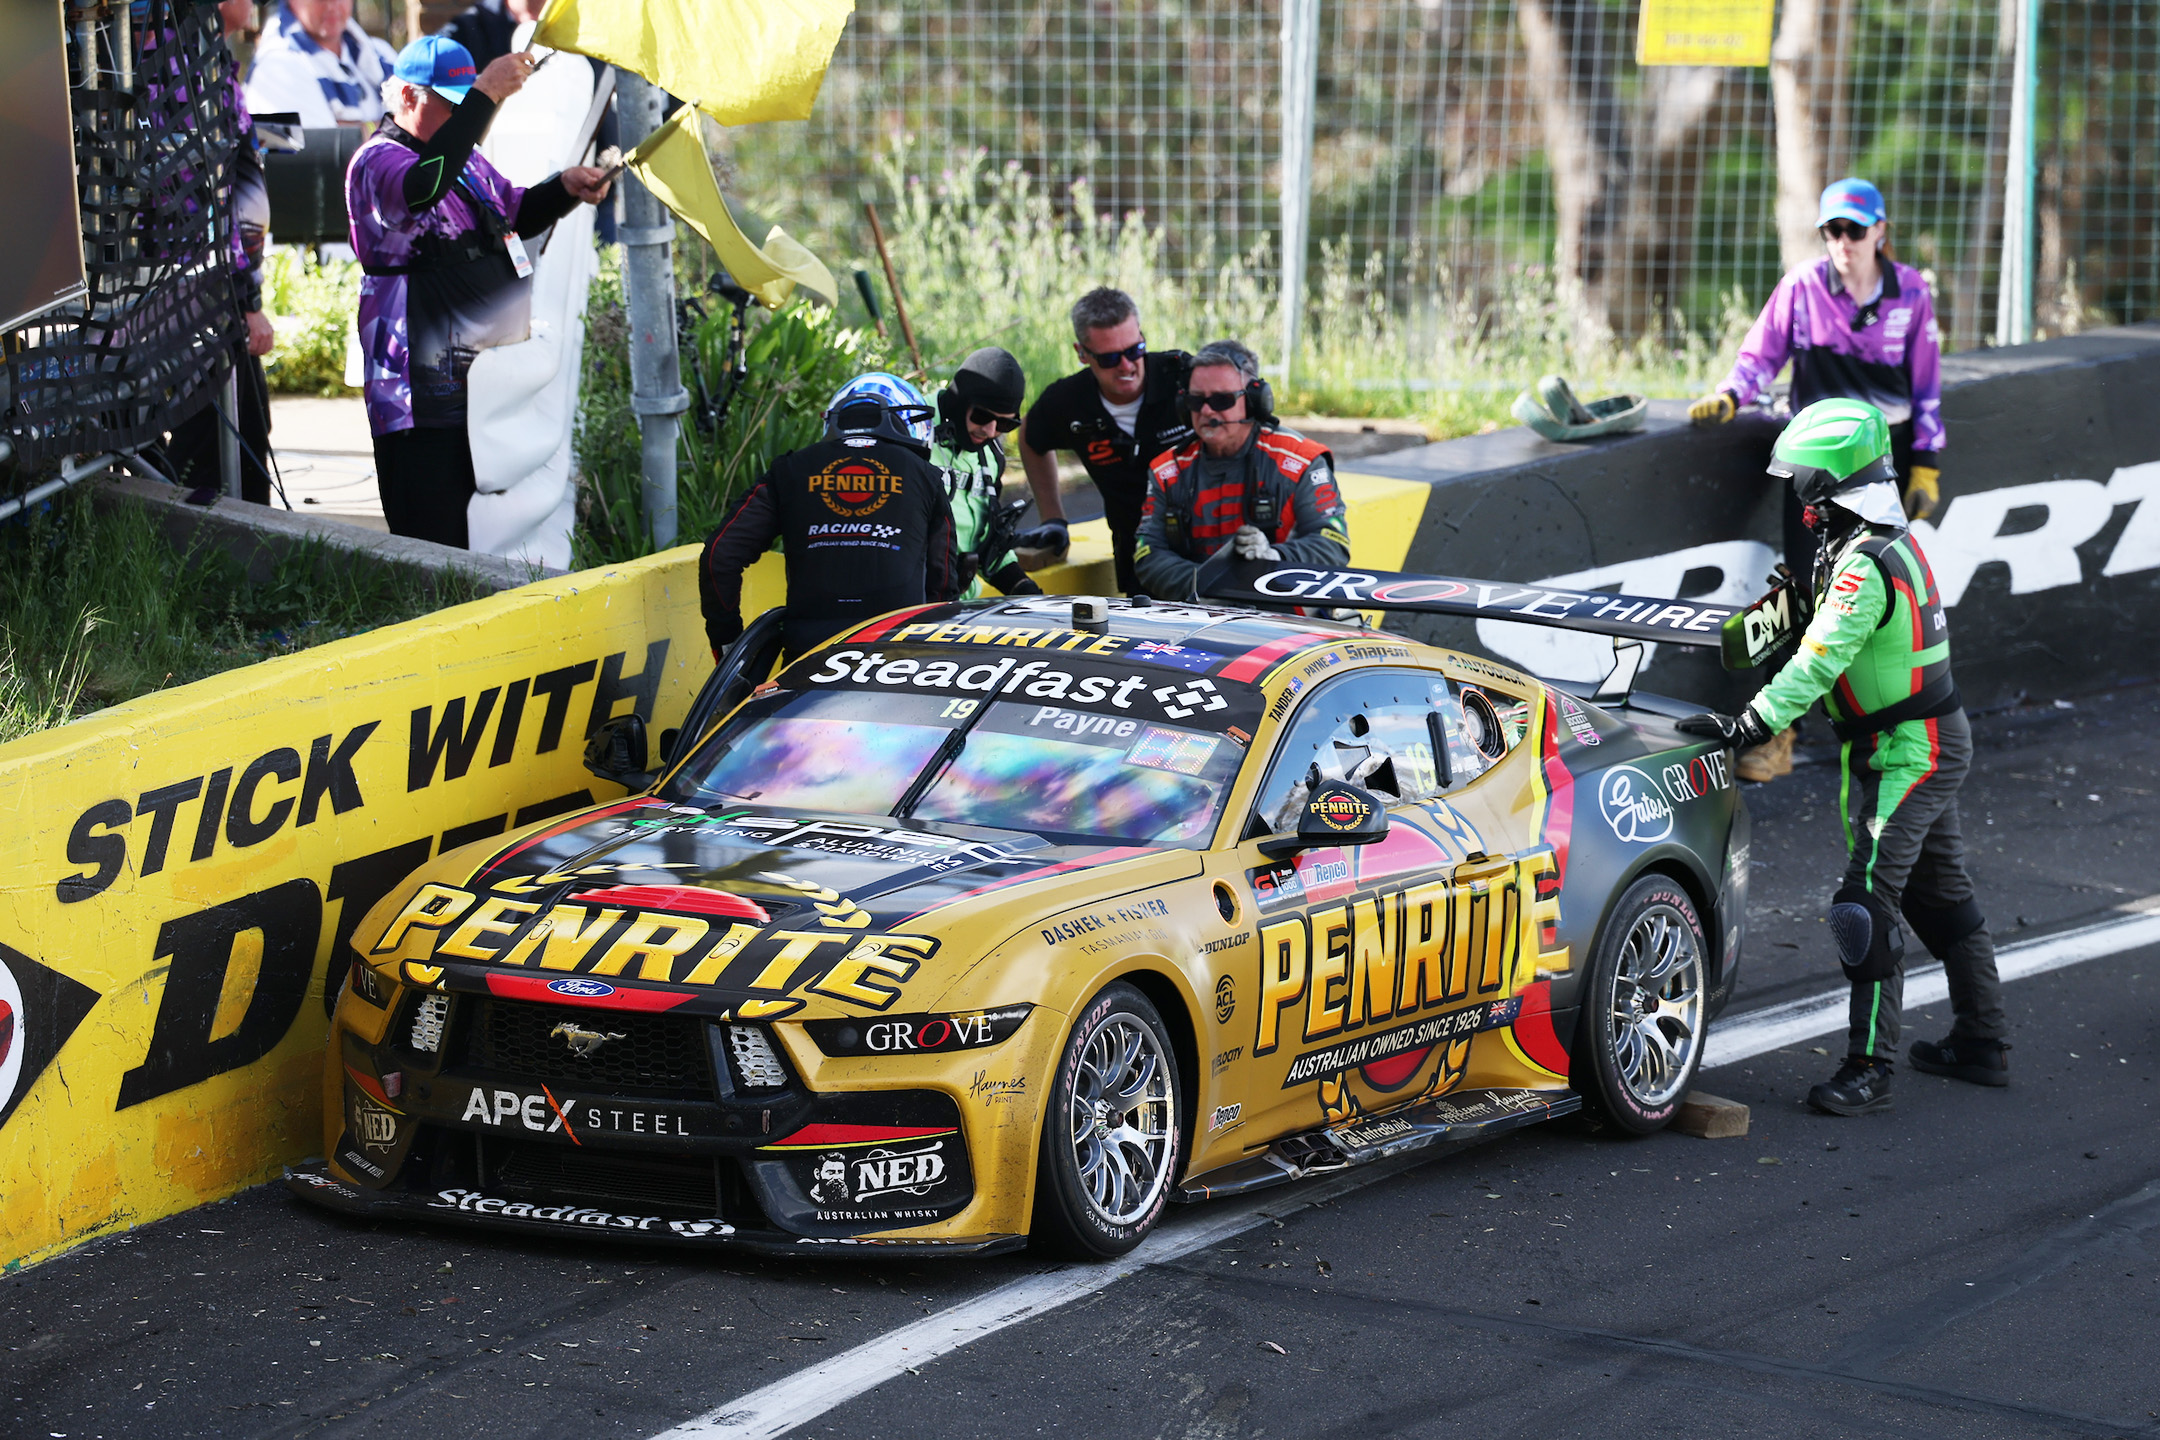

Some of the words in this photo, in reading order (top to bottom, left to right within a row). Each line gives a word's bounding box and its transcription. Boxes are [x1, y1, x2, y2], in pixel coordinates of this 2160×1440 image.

[808, 474, 903, 494] PENRITE
[809, 523, 872, 536] RACING
[1253, 568, 1591, 620] GROVE
[1592, 601, 1732, 632] HIRE
[890, 622, 1130, 657] PENRITE
[1743, 588, 1791, 658] D&M
[808, 650, 1148, 708] Steadfast
[1303, 656, 1330, 678] PAYNE
[1460, 658, 1526, 686] AUTODESK
[938, 698, 979, 721] 19
[1029, 705, 1138, 738] Payne
[1268, 687, 1296, 723] TANDER
[57, 720, 382, 903] STICK
[407, 638, 670, 794] WITH
[1405, 742, 1438, 795] 19
[1662, 749, 1731, 802] GROVE
[1310, 801, 1371, 816] PENRITE
[1609, 774, 1672, 842] Gates
[608, 826, 773, 840] EVRYTHING
[806, 837, 964, 867] ALUMINIUM
[814, 845, 950, 872] HARDWARE
[1312, 861, 1348, 884] Repco
[1041, 913, 1104, 946] DASHER
[1117, 899, 1169, 923] FISHER
[1652, 891, 1702, 938] DUNLOP
[373, 883, 936, 1008] PENRITE
[1079, 928, 1148, 956] TASMANIAN
[1204, 932, 1250, 955] DUNLOP
[1254, 847, 1573, 1057] PENRITE
[566, 980, 602, 996] Ford
[1216, 990, 1236, 1010] ACL
[865, 1014, 993, 1051] GROVE
[1065, 998, 1112, 1096] DUNLOP
[1287, 1045, 1367, 1082] AUSTRALIAN
[1370, 1027, 1415, 1058] OWNED
[1415, 1016, 1453, 1045] SINCE
[1453, 1007, 1484, 1034] 1926
[969, 1069, 1026, 1107] Haymes
[363, 1111, 397, 1142] NED
[461, 1083, 582, 1145] APEX
[588, 1108, 690, 1137] STEEL
[1213, 1103, 1242, 1128] Repco
[1358, 1117, 1413, 1143] InfraBuild
[345, 1151, 371, 1173] AUSTRALIAN
[857, 1153, 945, 1192] NED
[428, 1188, 661, 1230] Steadfast
[816, 1210, 888, 1221] AUSTRALIAN
[894, 1209, 939, 1219] WHISKY
